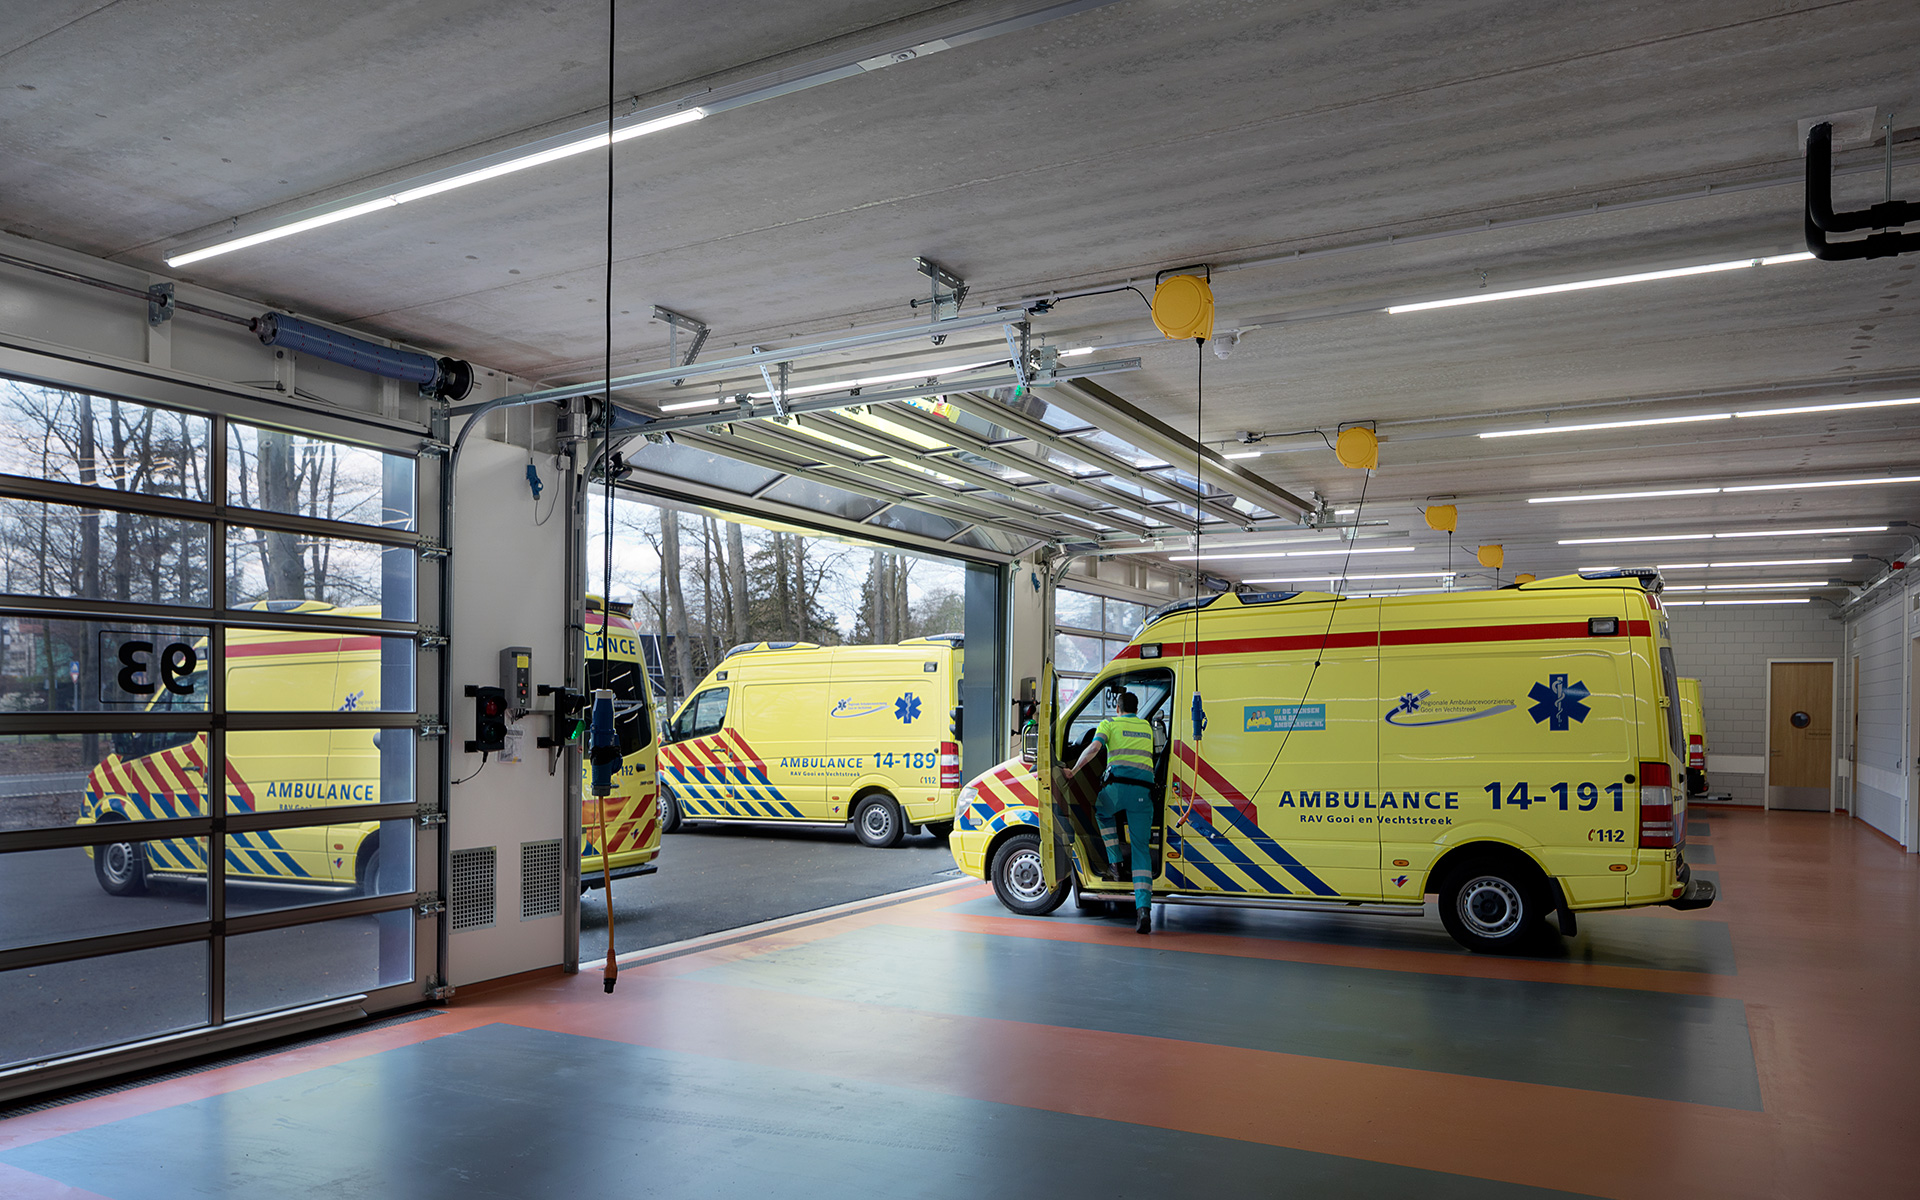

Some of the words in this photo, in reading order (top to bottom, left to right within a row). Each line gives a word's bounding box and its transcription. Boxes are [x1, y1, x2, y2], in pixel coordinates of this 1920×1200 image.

[585, 635, 636, 655] LANCE
[1450, 698, 1515, 706] Ambulancevoorziening
[780, 757, 863, 769] AMBULANCE
[873, 752, 936, 769] 14-189
[266, 782, 374, 801] AMBULANCE
[1278, 790, 1459, 810] AMBULANCE
[1484, 782, 1624, 812] 14-191
[1300, 815, 1323, 823] RAV
[1327, 815, 1355, 824] Gooi
[1358, 816, 1373, 824] en
[1377, 815, 1453, 825] Vechtstreek
